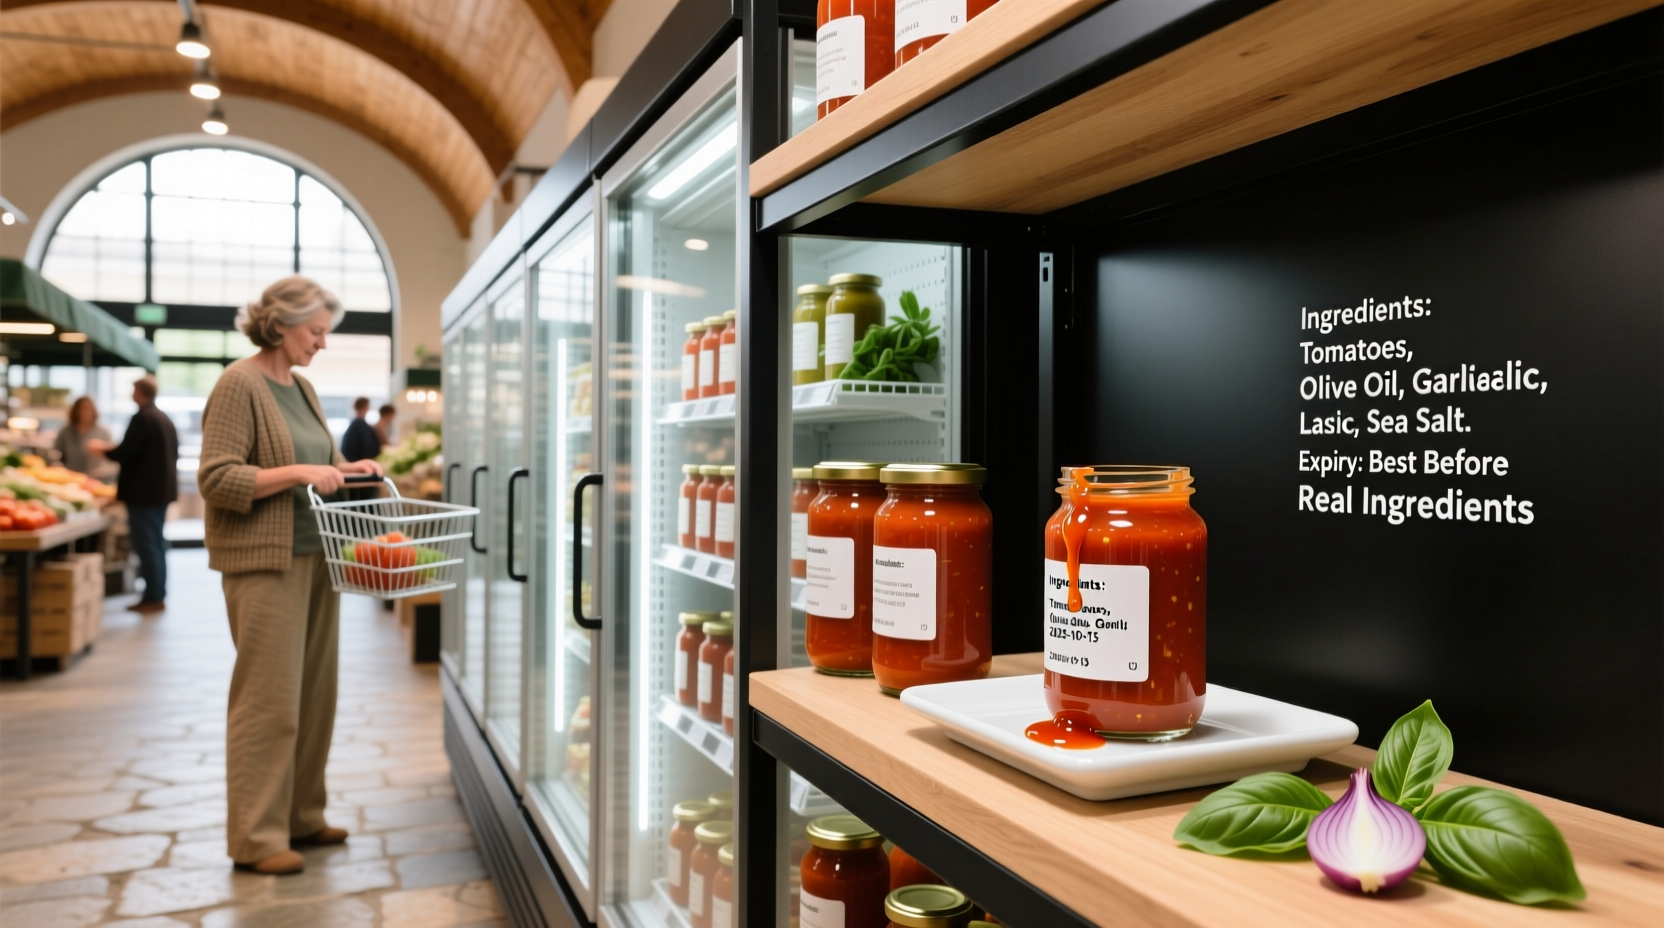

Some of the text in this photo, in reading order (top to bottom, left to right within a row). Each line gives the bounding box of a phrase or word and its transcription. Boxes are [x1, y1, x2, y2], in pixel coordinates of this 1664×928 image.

[1301, 296, 1432, 334] Ingredients:
[1300, 340, 1413, 364] Tomatoes,
[1300, 375, 1357, 400] Olive
[1364, 370, 1404, 400] Oil,
[1300, 406, 1471, 438] Lasic, Sea Salt.
[1299, 448, 1509, 477] Expiry: Best Before
[1299, 485, 1534, 525] Real Ingredients
